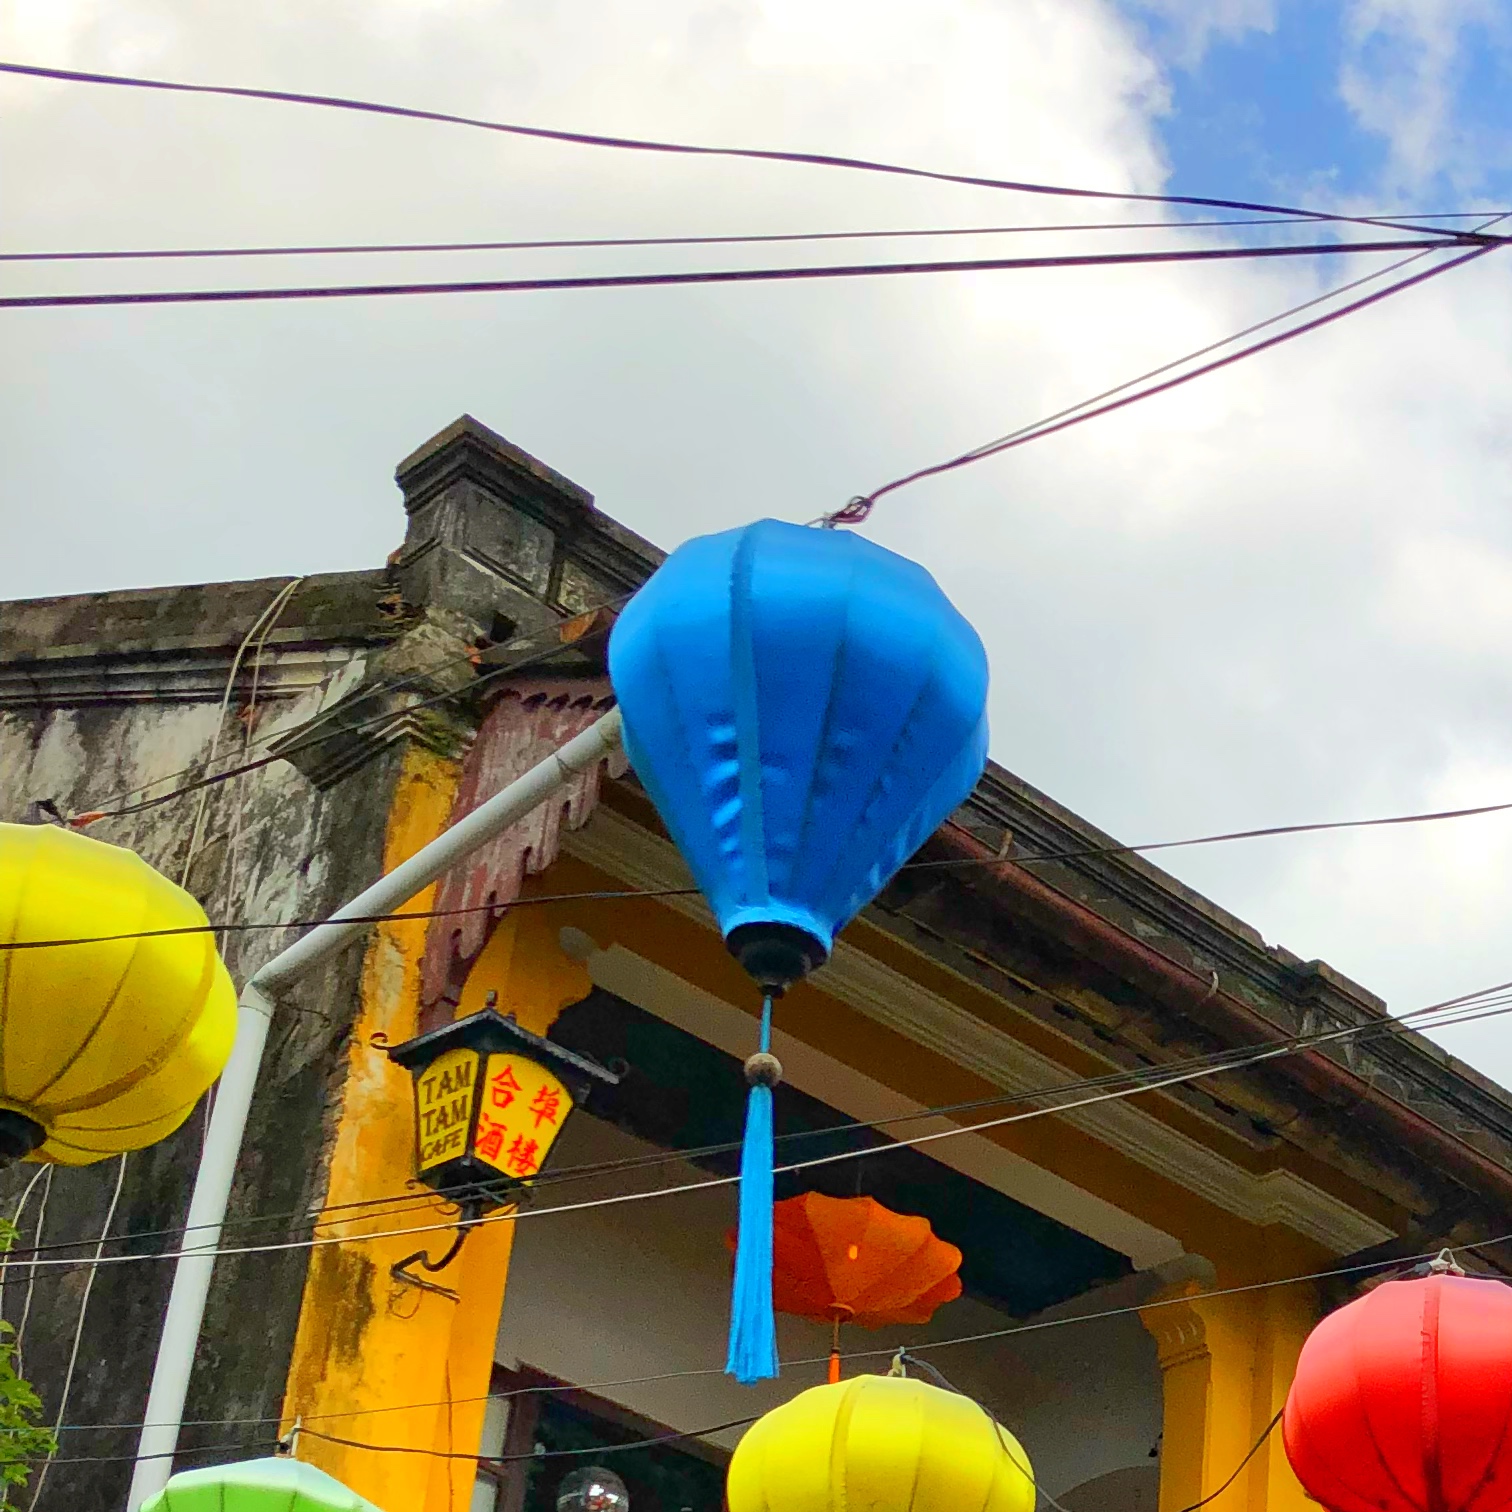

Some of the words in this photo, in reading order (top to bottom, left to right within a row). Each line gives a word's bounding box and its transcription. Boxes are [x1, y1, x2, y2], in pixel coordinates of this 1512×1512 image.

[423, 1061, 471, 1104] TAM
[421, 1094, 469, 1137] TAM
[421, 1128, 463, 1162] CAFE
